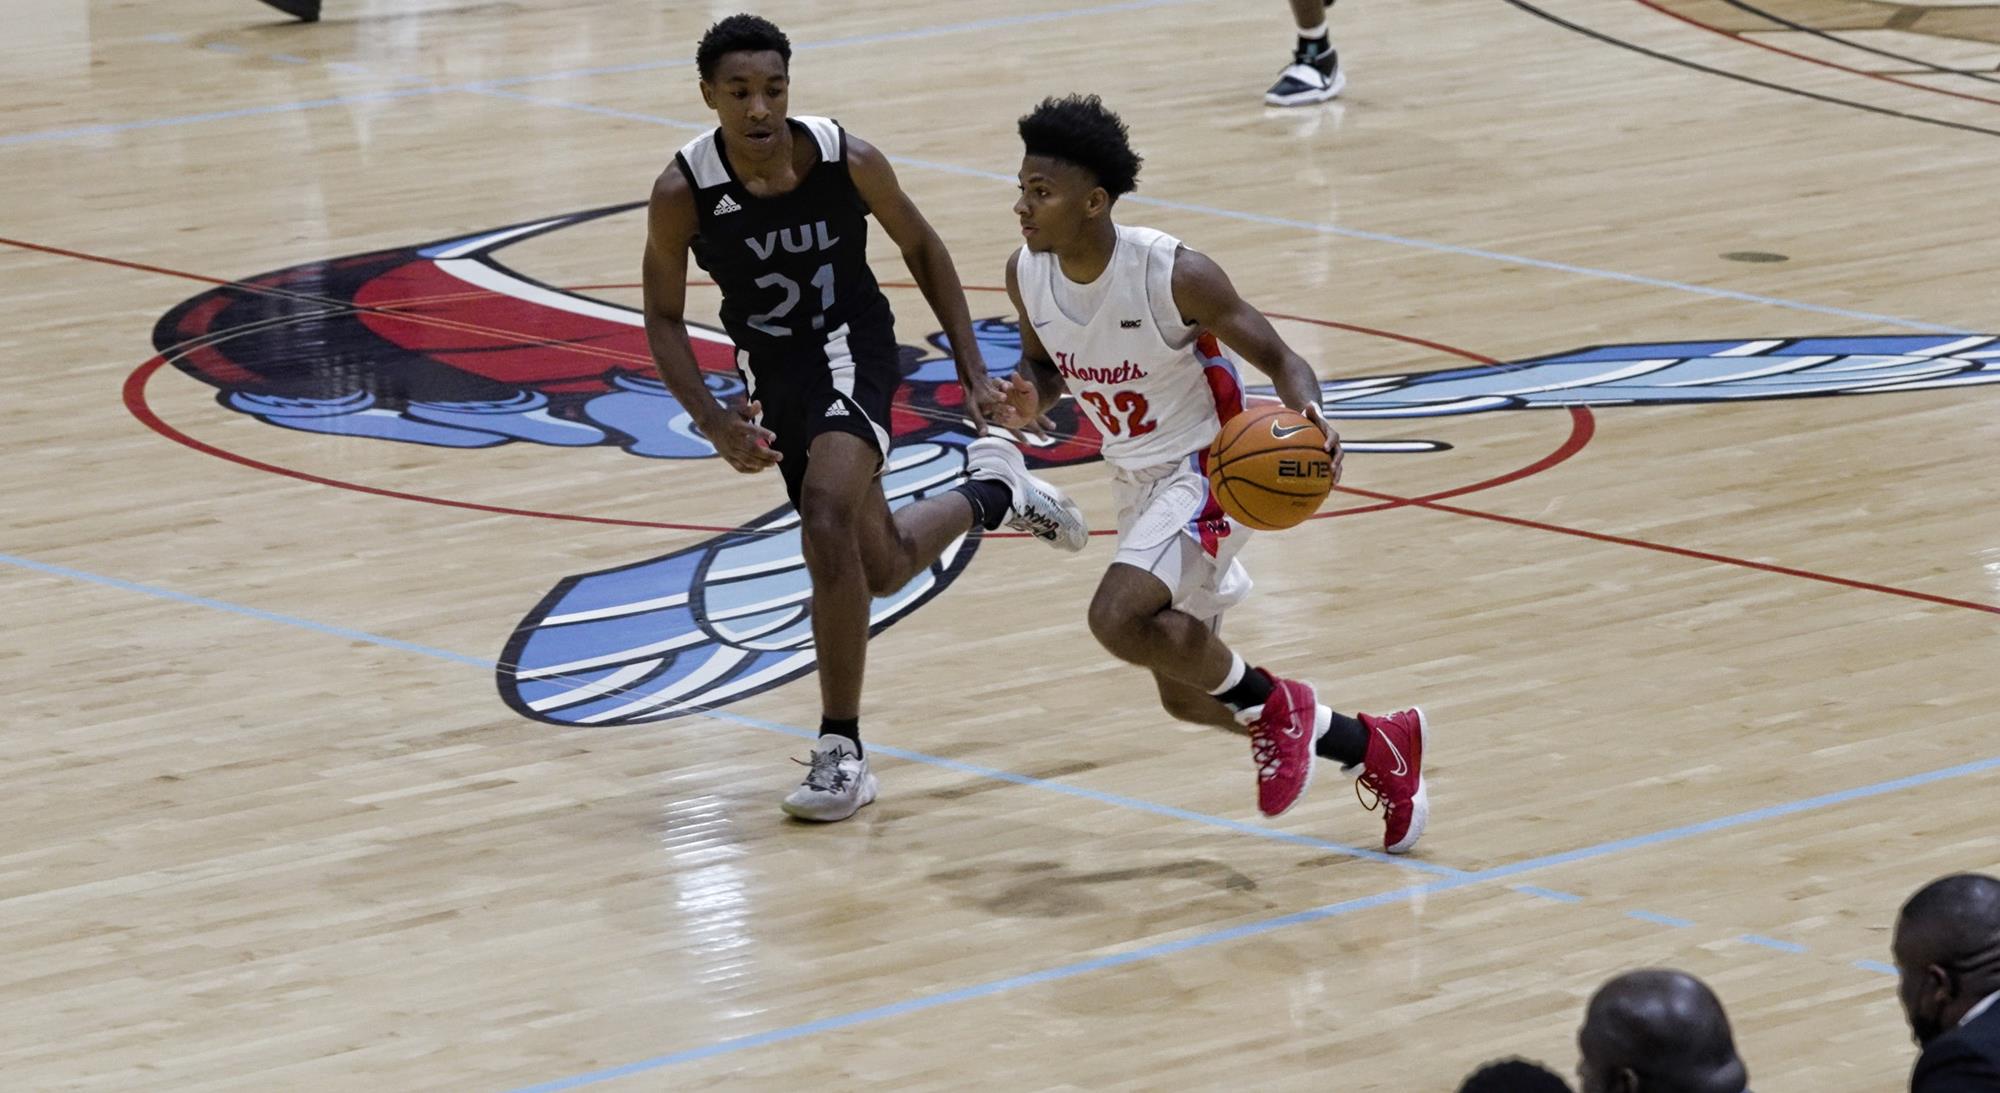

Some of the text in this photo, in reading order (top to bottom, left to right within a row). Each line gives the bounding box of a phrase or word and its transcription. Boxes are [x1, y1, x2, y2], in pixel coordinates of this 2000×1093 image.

[744, 220, 840, 261] VUL
[747, 263, 836, 337] 21
[1056, 351, 1148, 385] Hornets
[1081, 390, 1158, 438] 32
[1278, 460, 1329, 478] ELITE
